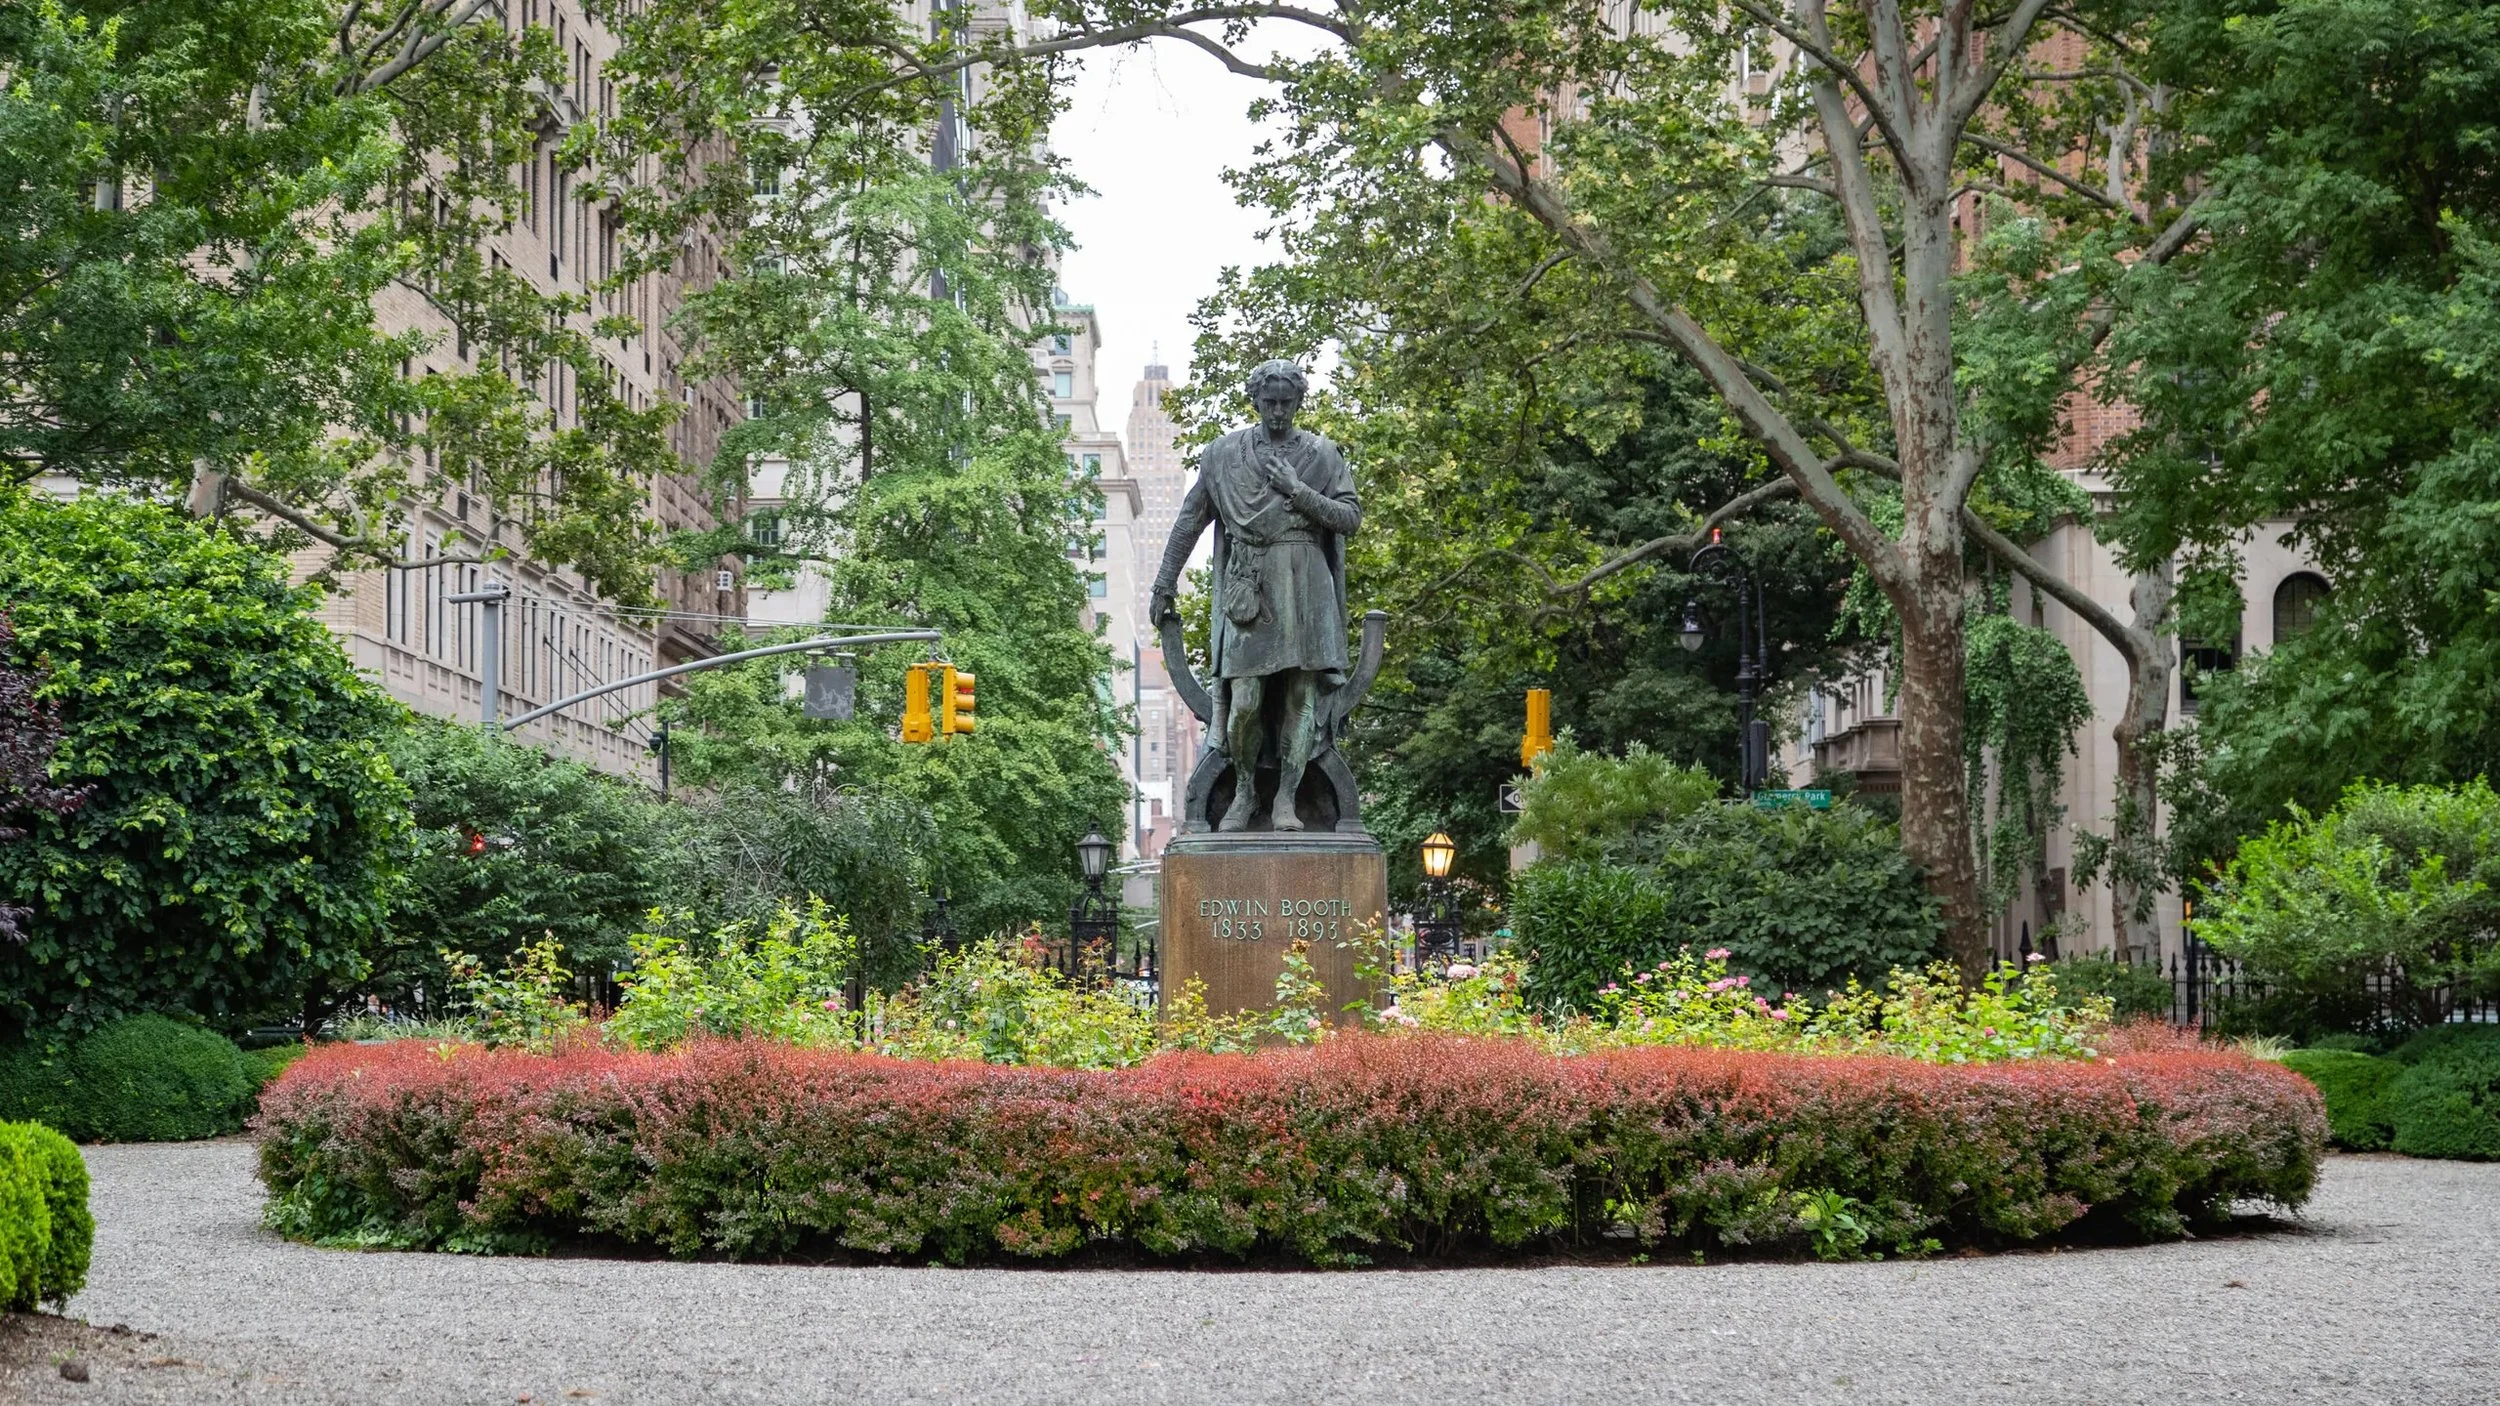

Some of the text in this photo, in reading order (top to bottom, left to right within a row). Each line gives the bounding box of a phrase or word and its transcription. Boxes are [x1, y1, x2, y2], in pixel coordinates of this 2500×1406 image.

[1805, 791, 1826, 801] Park
[1200, 899, 1351, 917] EDWIN BOOTH
[1212, 918, 1338, 942] 1833 1893
